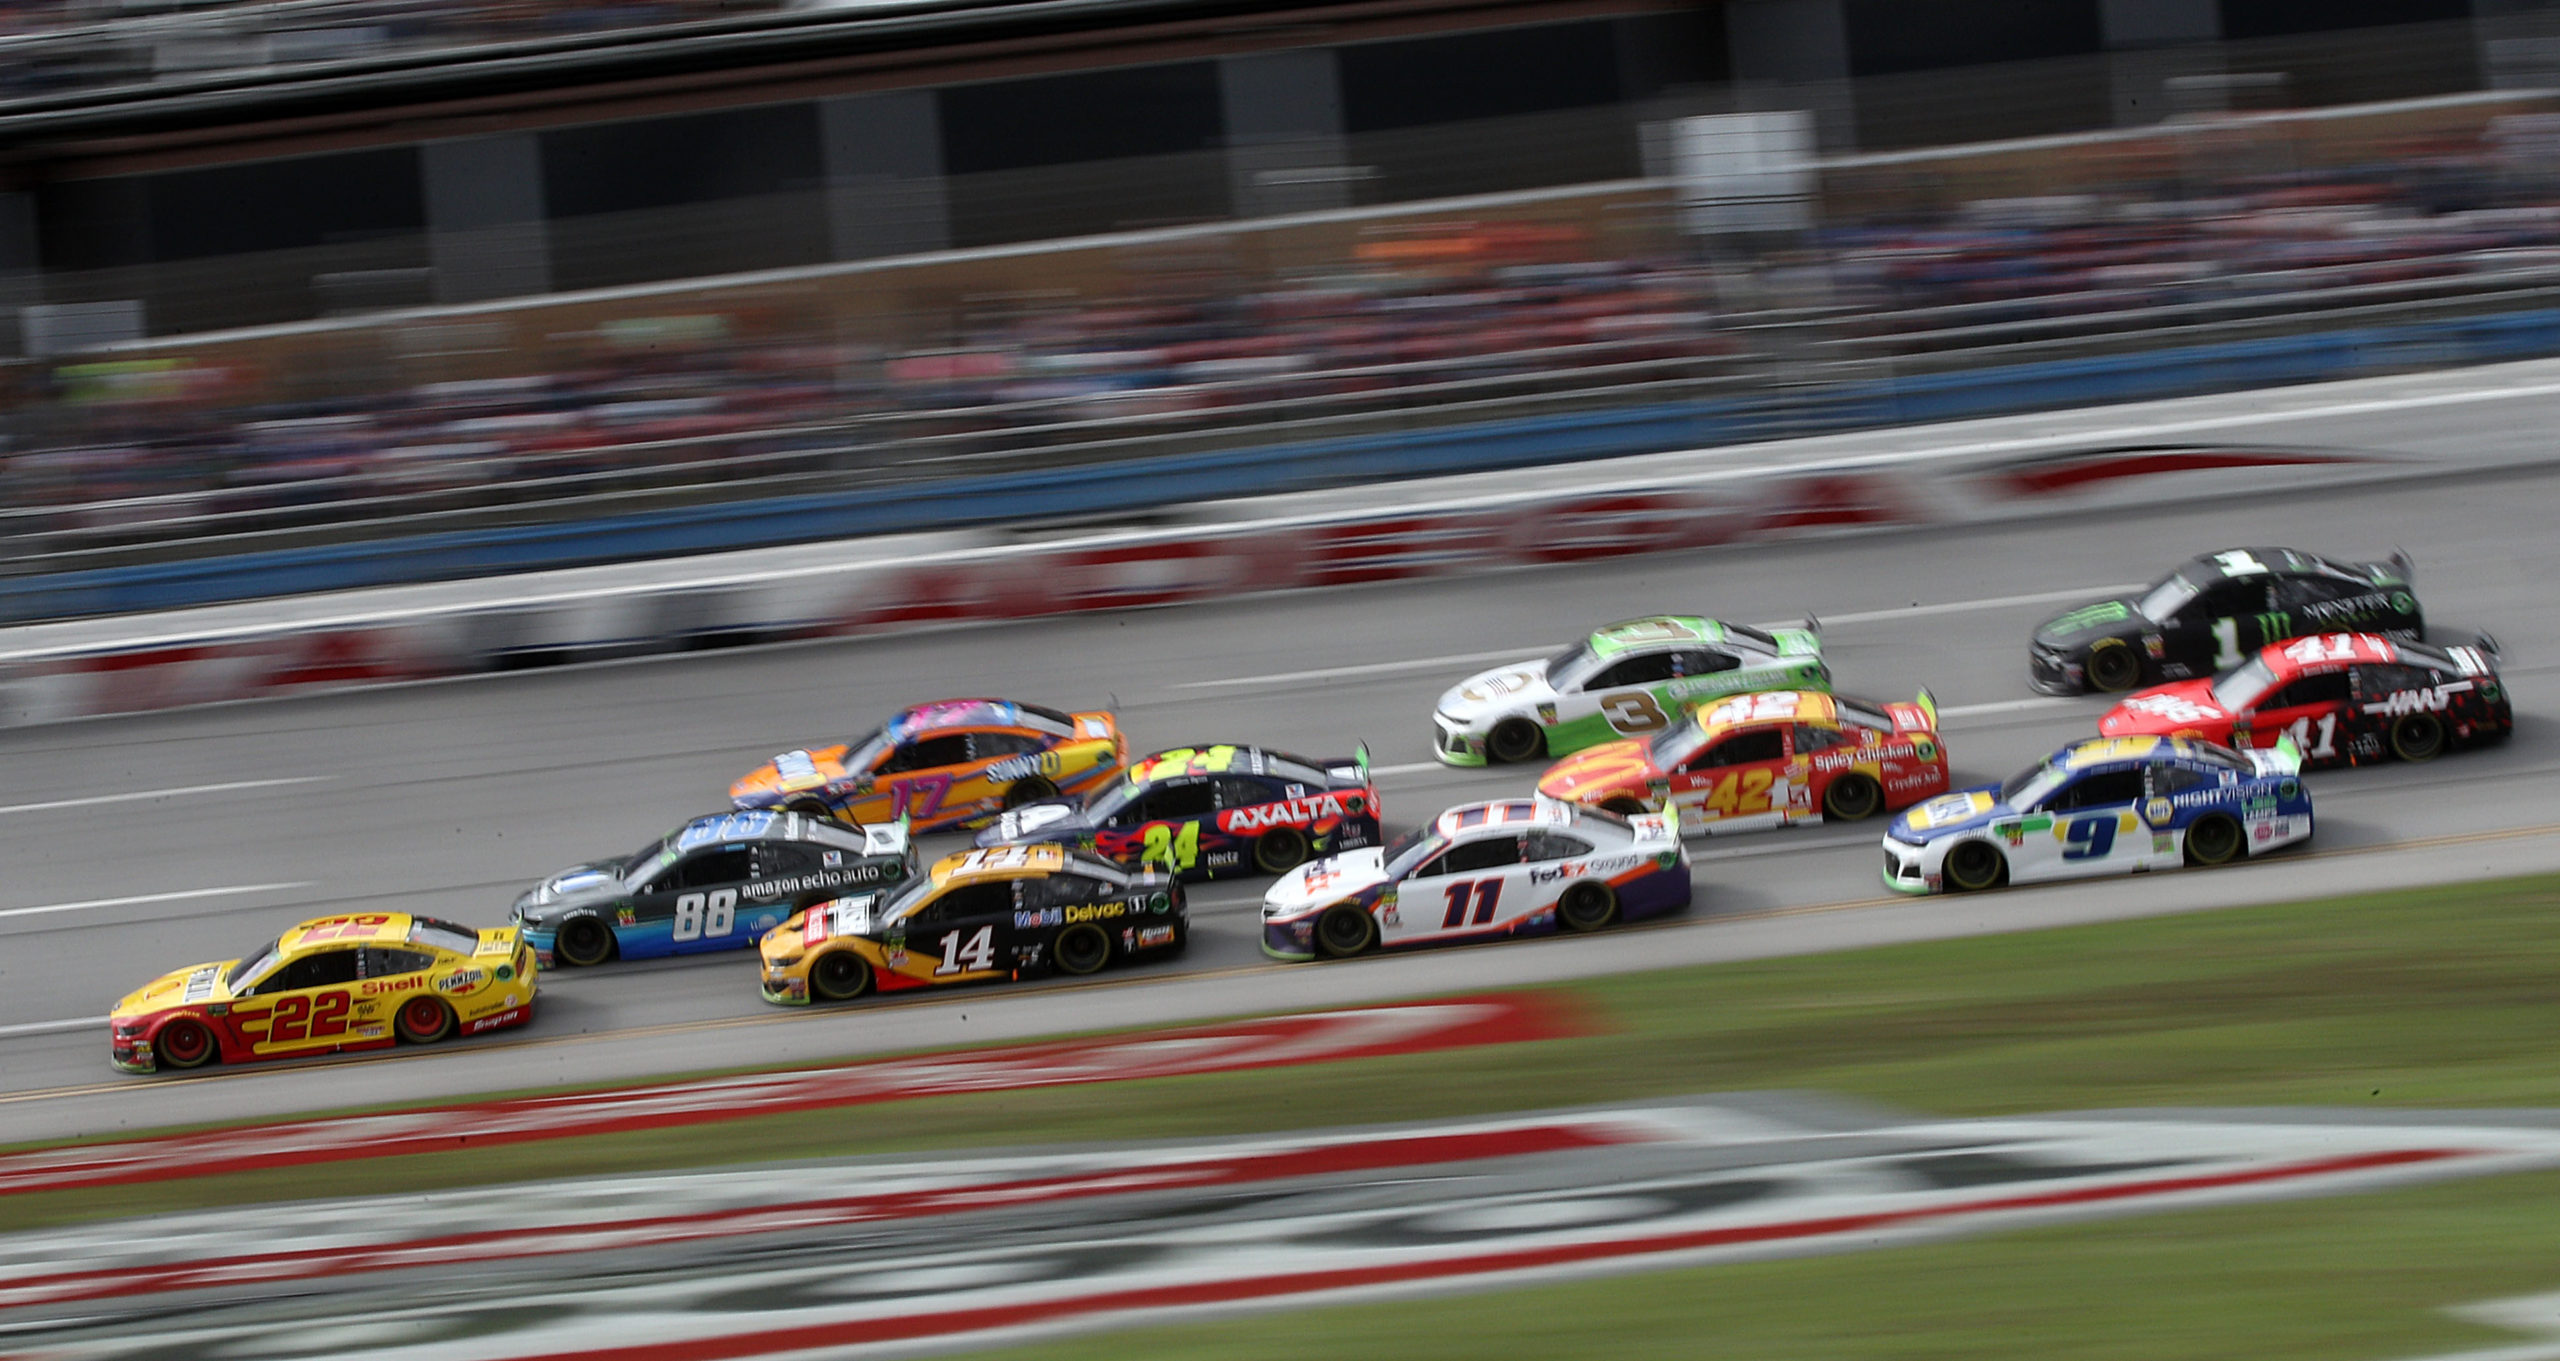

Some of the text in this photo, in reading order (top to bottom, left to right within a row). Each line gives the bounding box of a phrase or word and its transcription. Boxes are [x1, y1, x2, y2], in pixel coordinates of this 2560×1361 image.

[2211, 616, 2246, 670] 1
[2284, 632, 2357, 665] 41
[1600, 688, 1671, 737] 3
[891, 772, 953, 821] 17
[1228, 795, 1343, 832] AXALTA
[1705, 768, 1773, 816] 42
[951, 845, 1030, 876] 14
[1141, 820, 1200, 870] 24
[2063, 814, 2120, 860] 9
[742, 866, 879, 900] amazon echo auto
[1530, 862, 1587, 885] FedEx
[672, 888, 738, 942] 88
[1014, 906, 1063, 928] Mobil
[1065, 901, 1126, 924] Delvac
[1441, 875, 1505, 929] 11
[932, 925, 996, 976] 14
[361, 976, 424, 996] Shell
[438, 968, 485, 991] PENNZOIL
[270, 990, 352, 1043] 22
